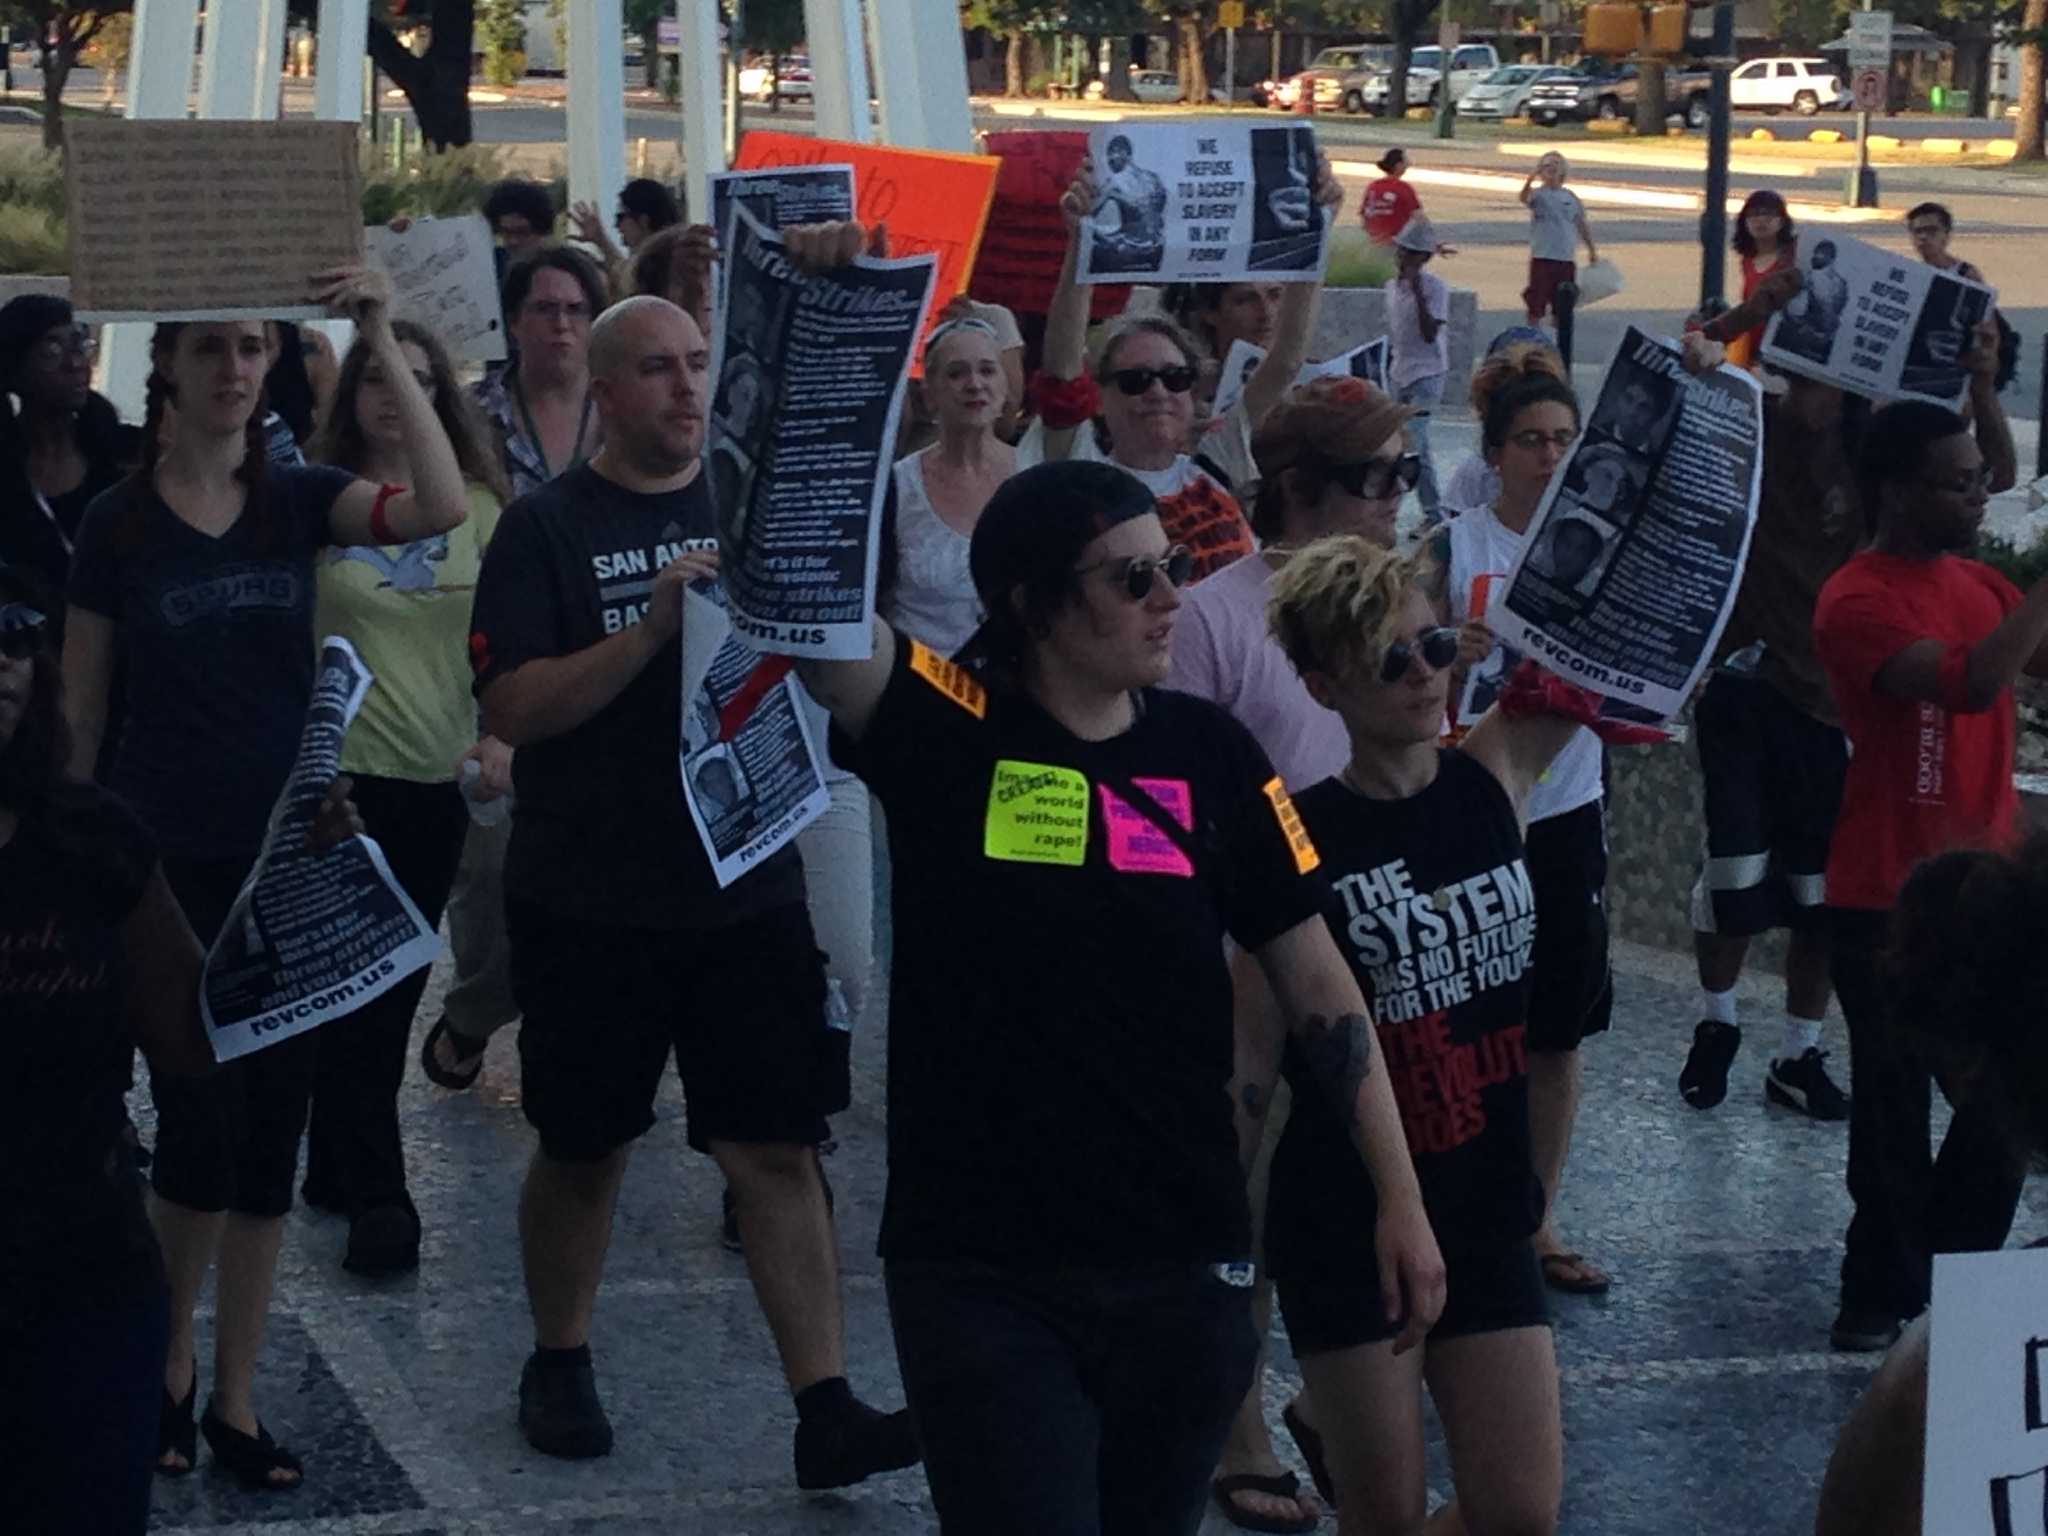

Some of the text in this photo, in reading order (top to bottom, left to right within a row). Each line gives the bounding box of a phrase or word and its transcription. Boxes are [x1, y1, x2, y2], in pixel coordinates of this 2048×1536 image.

[1197, 139, 1218, 154] WE
[1185, 161, 1233, 176] REFUSE
[1177, 181, 1246, 198] TO ACCEPT
[1181, 204, 1237, 220] SLAVERY
[1188, 226, 1231, 242] IN ANY
[1187, 248, 1228, 262] FORM
[592, 549, 649, 580] SAN
[1522, 627, 1647, 696] revcom.us
[1035, 795, 1084, 810] world
[1015, 813, 1084, 828] without
[1033, 833, 1084, 849] rape!
[1332, 858, 1416, 919] THE
[1348, 858, 1537, 967] SYSTEM
[1418, 945, 1454, 983] NO
[249, 958, 397, 1037] revcom.us
[1373, 989, 1425, 1028] FOR
[1424, 973, 1473, 1013] THE
